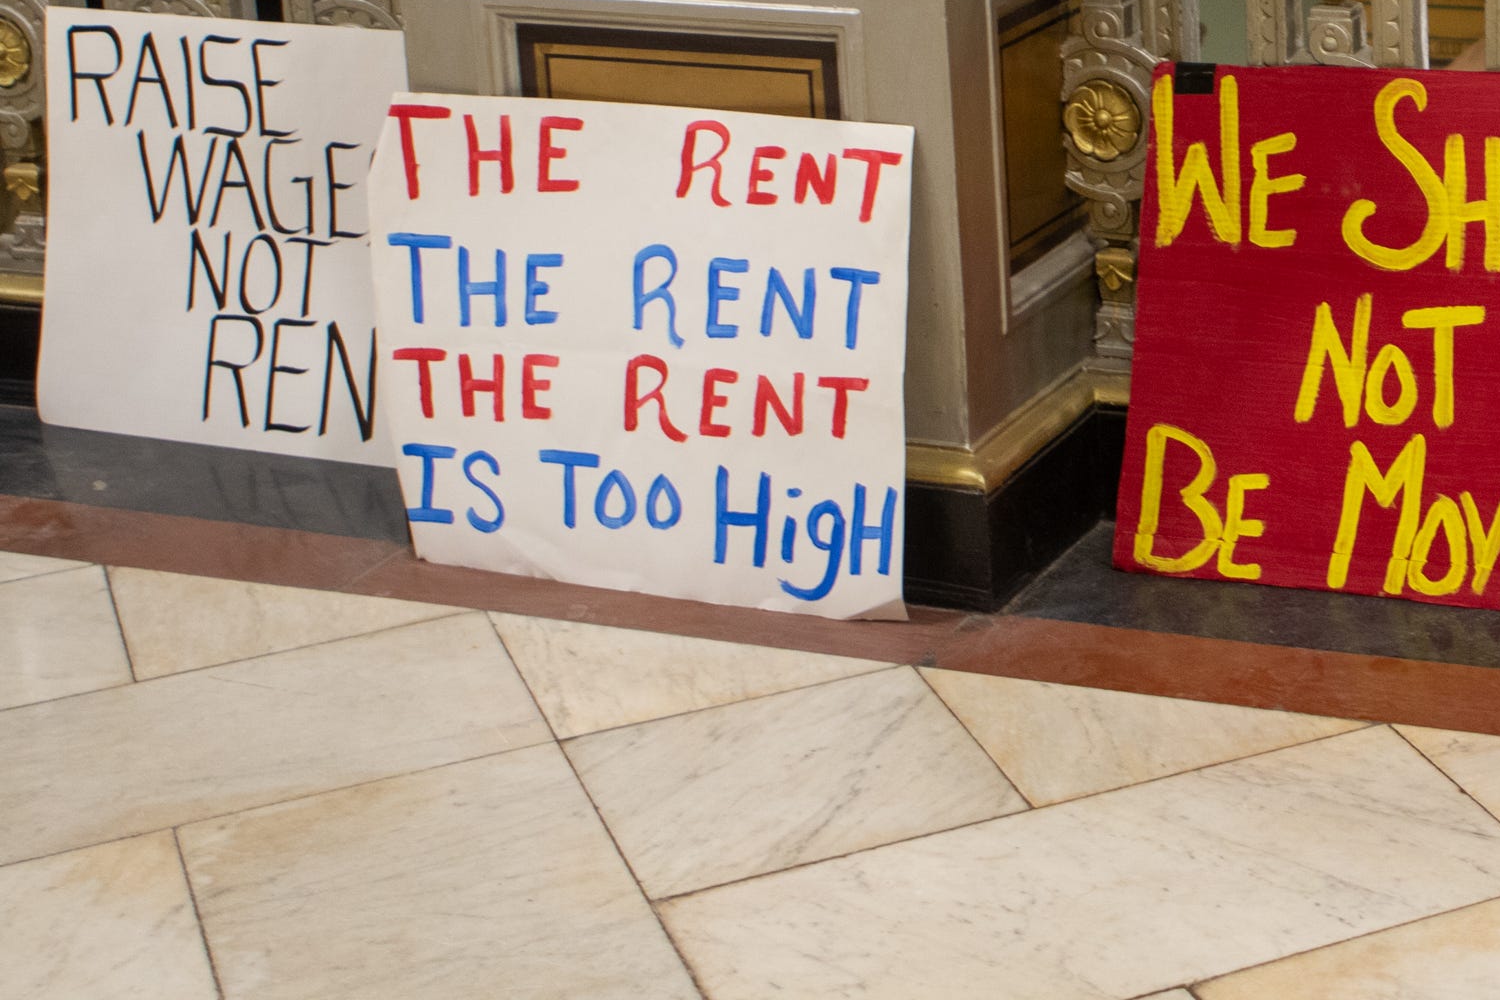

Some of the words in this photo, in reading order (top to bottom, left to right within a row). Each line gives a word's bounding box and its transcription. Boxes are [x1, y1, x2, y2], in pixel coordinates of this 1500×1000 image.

[66, 24, 297, 139] RAISE
[137, 130, 376, 242] WAGE
[388, 104, 584, 200] THE
[676, 119, 903, 223] RENT
[1152, 73, 1306, 248] WE
[186, 228, 340, 317] NOT
[387, 232, 564, 327] THE
[632, 243, 881, 350] RENT
[202, 313, 378, 443] REN
[392, 347, 559, 422] THE
[623, 353, 870, 443] RENT
[402, 443, 504, 534] IS
[538, 449, 682, 530] TOO
[1133, 423, 1270, 580] BE
